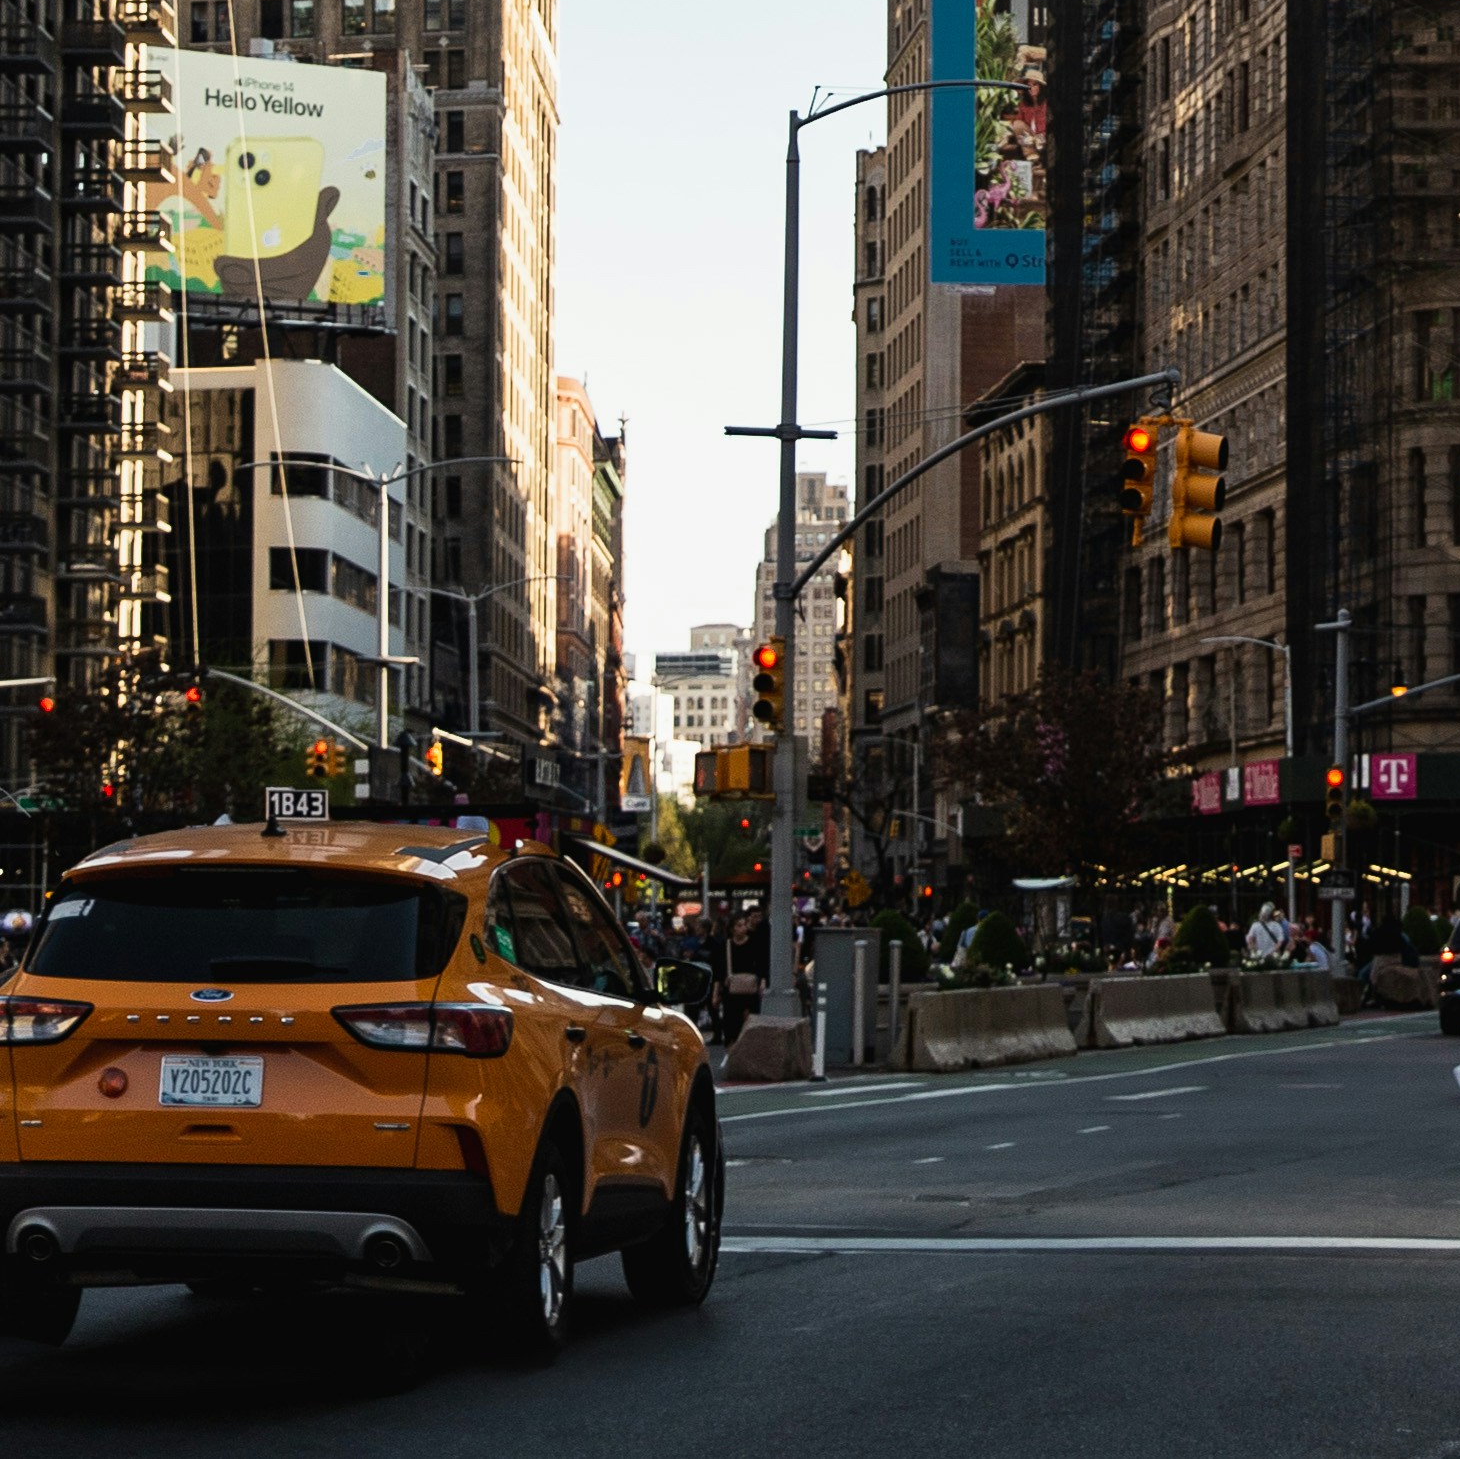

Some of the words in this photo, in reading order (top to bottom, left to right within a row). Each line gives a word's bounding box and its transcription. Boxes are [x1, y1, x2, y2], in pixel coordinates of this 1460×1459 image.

[243, 77, 281, 91] iPhone
[283, 81, 294, 92] 14
[205, 88, 257, 111] Hello
[260, 94, 324, 117] Yellow
[188, 1059, 209, 1068] NEW
[212, 1060, 237, 1068] YORK
[171, 1068, 252, 1094] Y205202C
